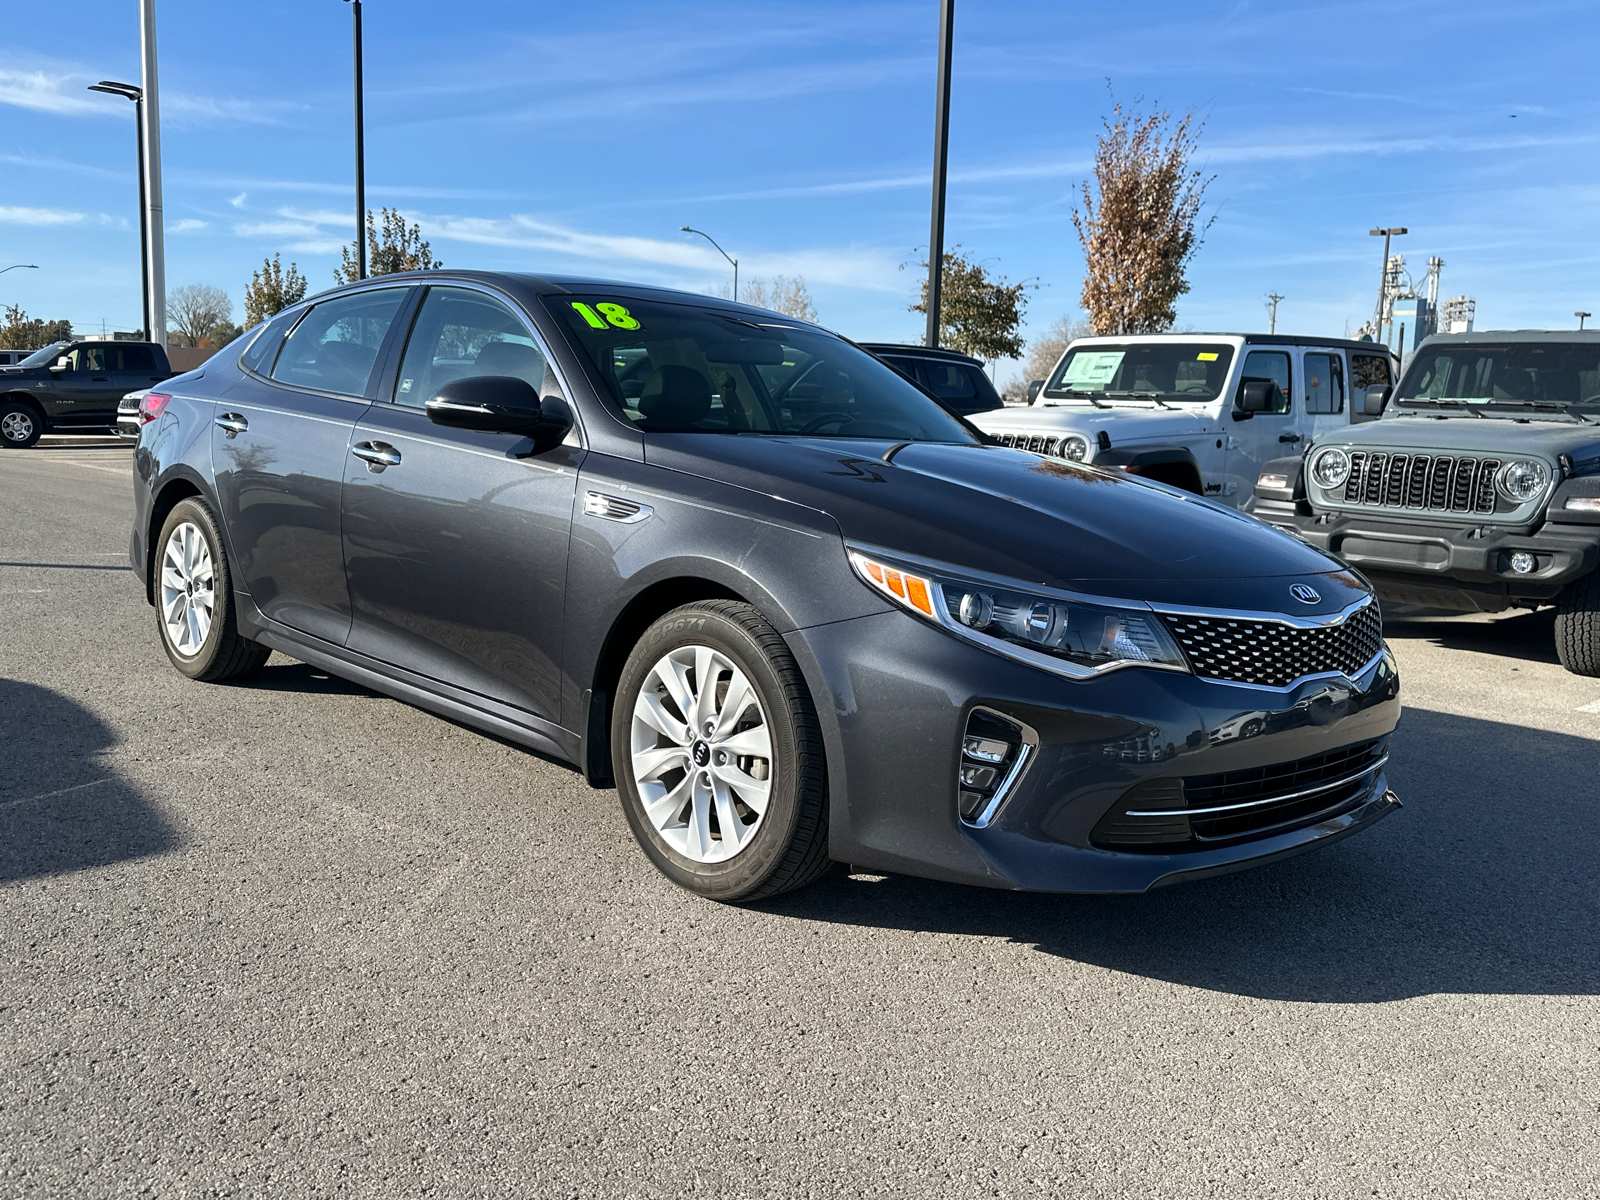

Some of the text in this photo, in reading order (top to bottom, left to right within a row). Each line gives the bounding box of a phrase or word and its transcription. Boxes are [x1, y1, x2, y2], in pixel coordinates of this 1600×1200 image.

[571, 302, 641, 330] 18
[1205, 482, 1222, 493] Jeep
[1293, 586, 1320, 599] KIA
[648, 617, 706, 645] CP671
[695, 742, 706, 763] KIA
